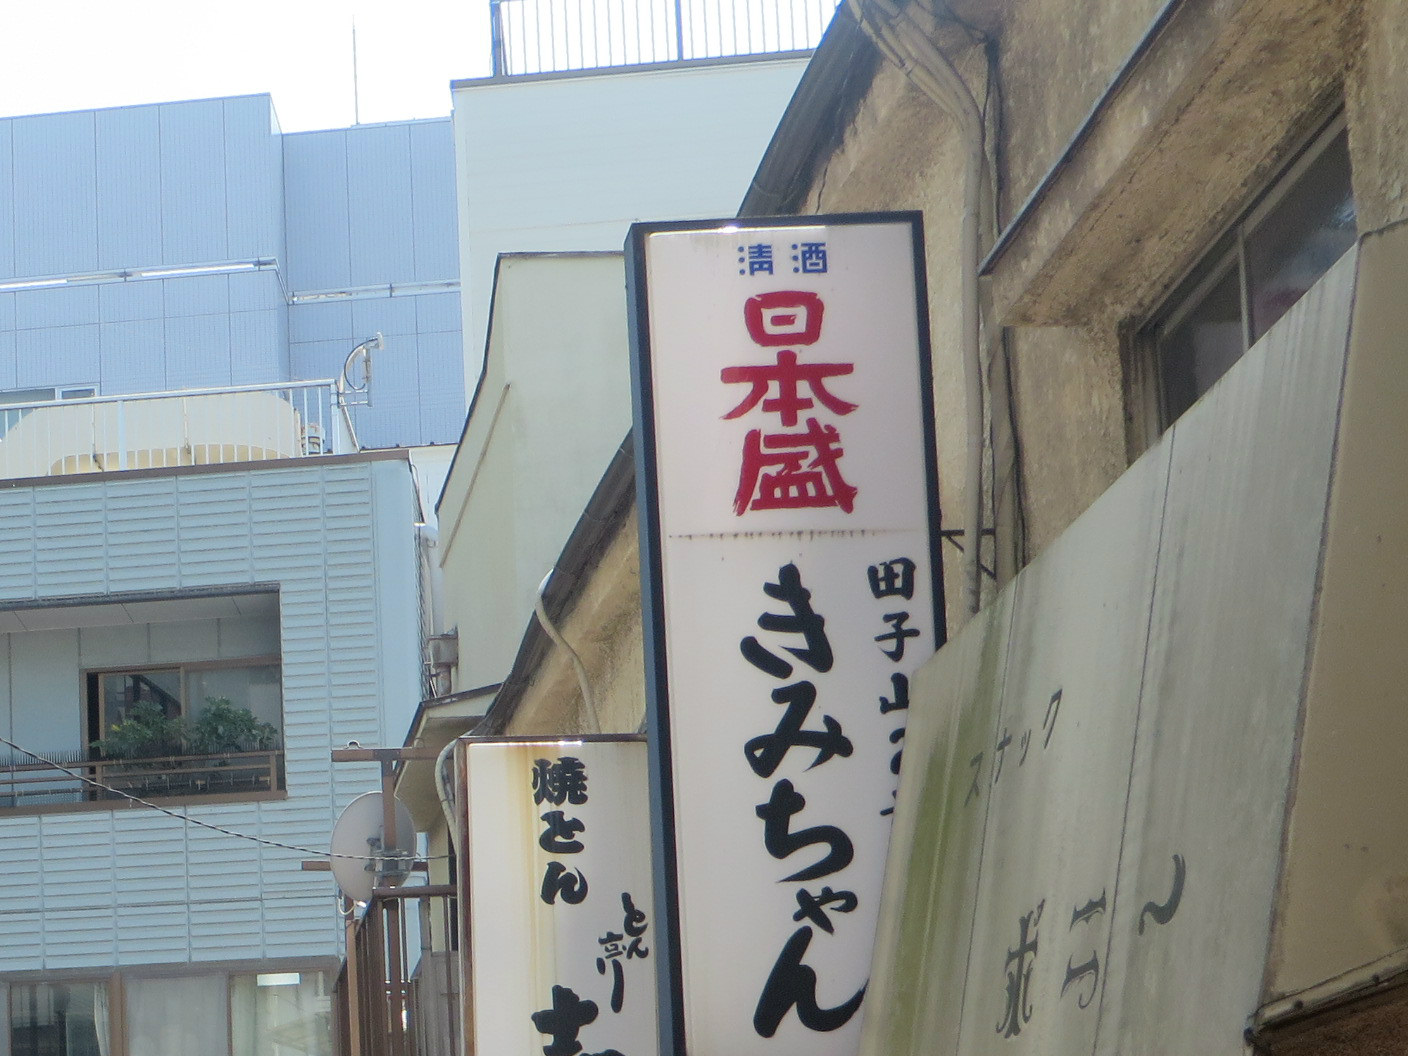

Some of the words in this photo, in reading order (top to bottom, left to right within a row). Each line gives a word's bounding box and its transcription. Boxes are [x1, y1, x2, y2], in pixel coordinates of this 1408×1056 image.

[737, 242, 830, 276] 清酒
[720, 291, 859, 517] 日本盛
[740, 563, 867, 1039] きみちゃん
[965, 688, 1063, 807] スナック
